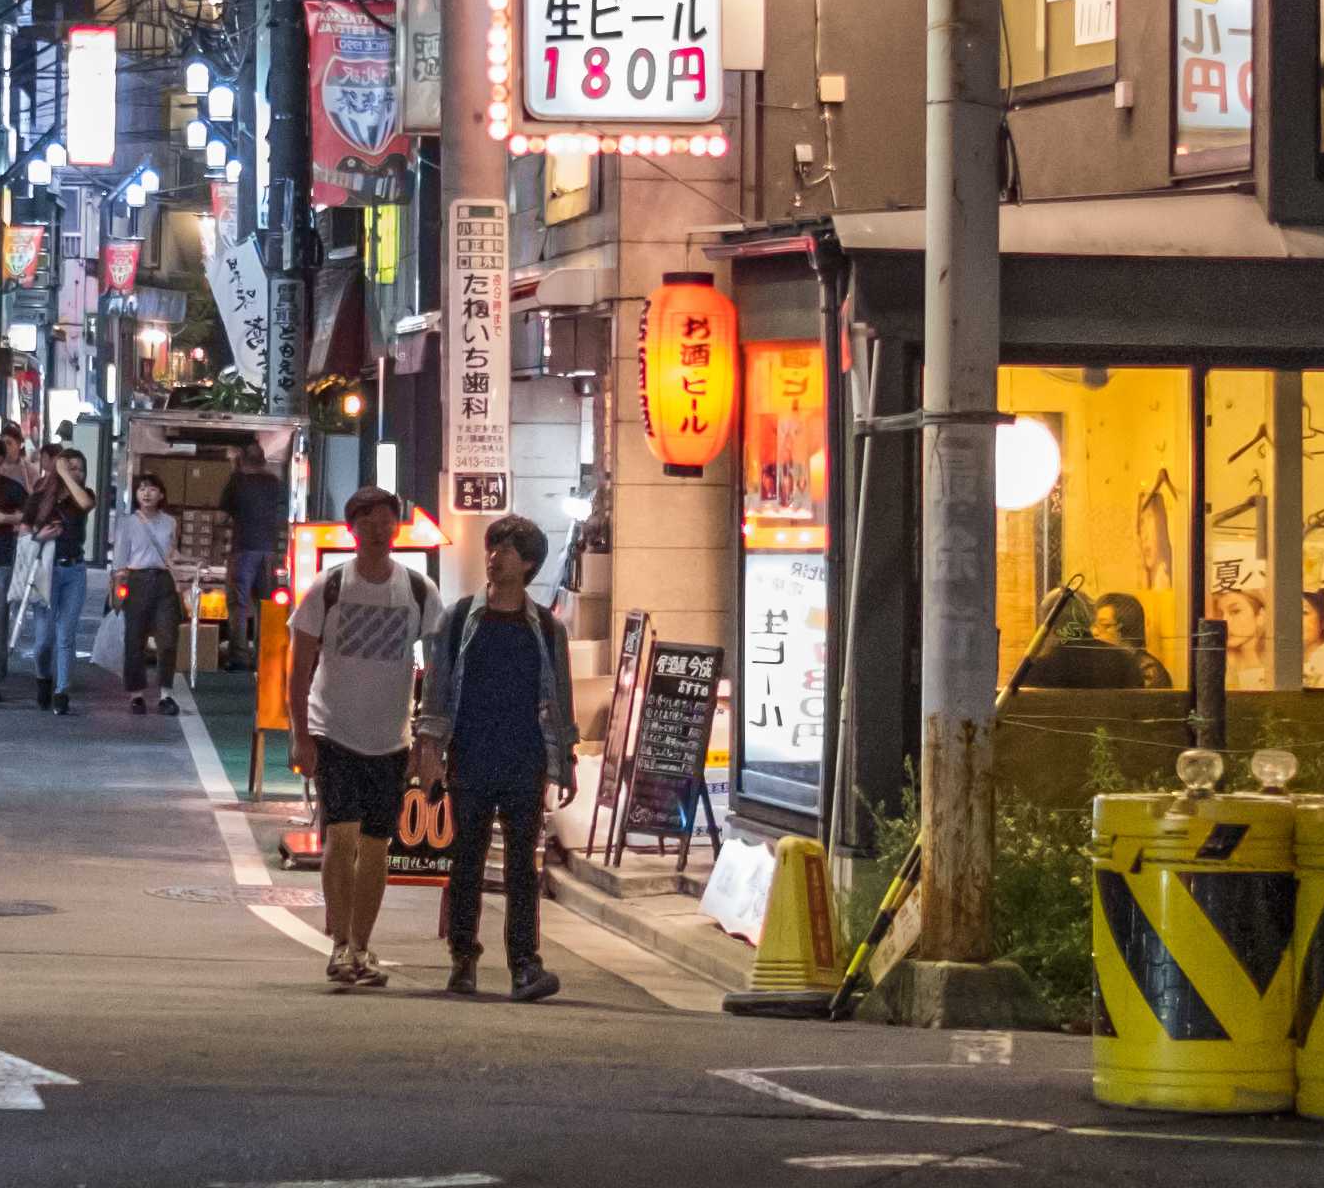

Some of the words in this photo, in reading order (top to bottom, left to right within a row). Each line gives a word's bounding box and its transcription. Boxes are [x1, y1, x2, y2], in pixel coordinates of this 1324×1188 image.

[545, 46, 706, 100] 180円
[462, 273, 491, 420] たねいち歯科
